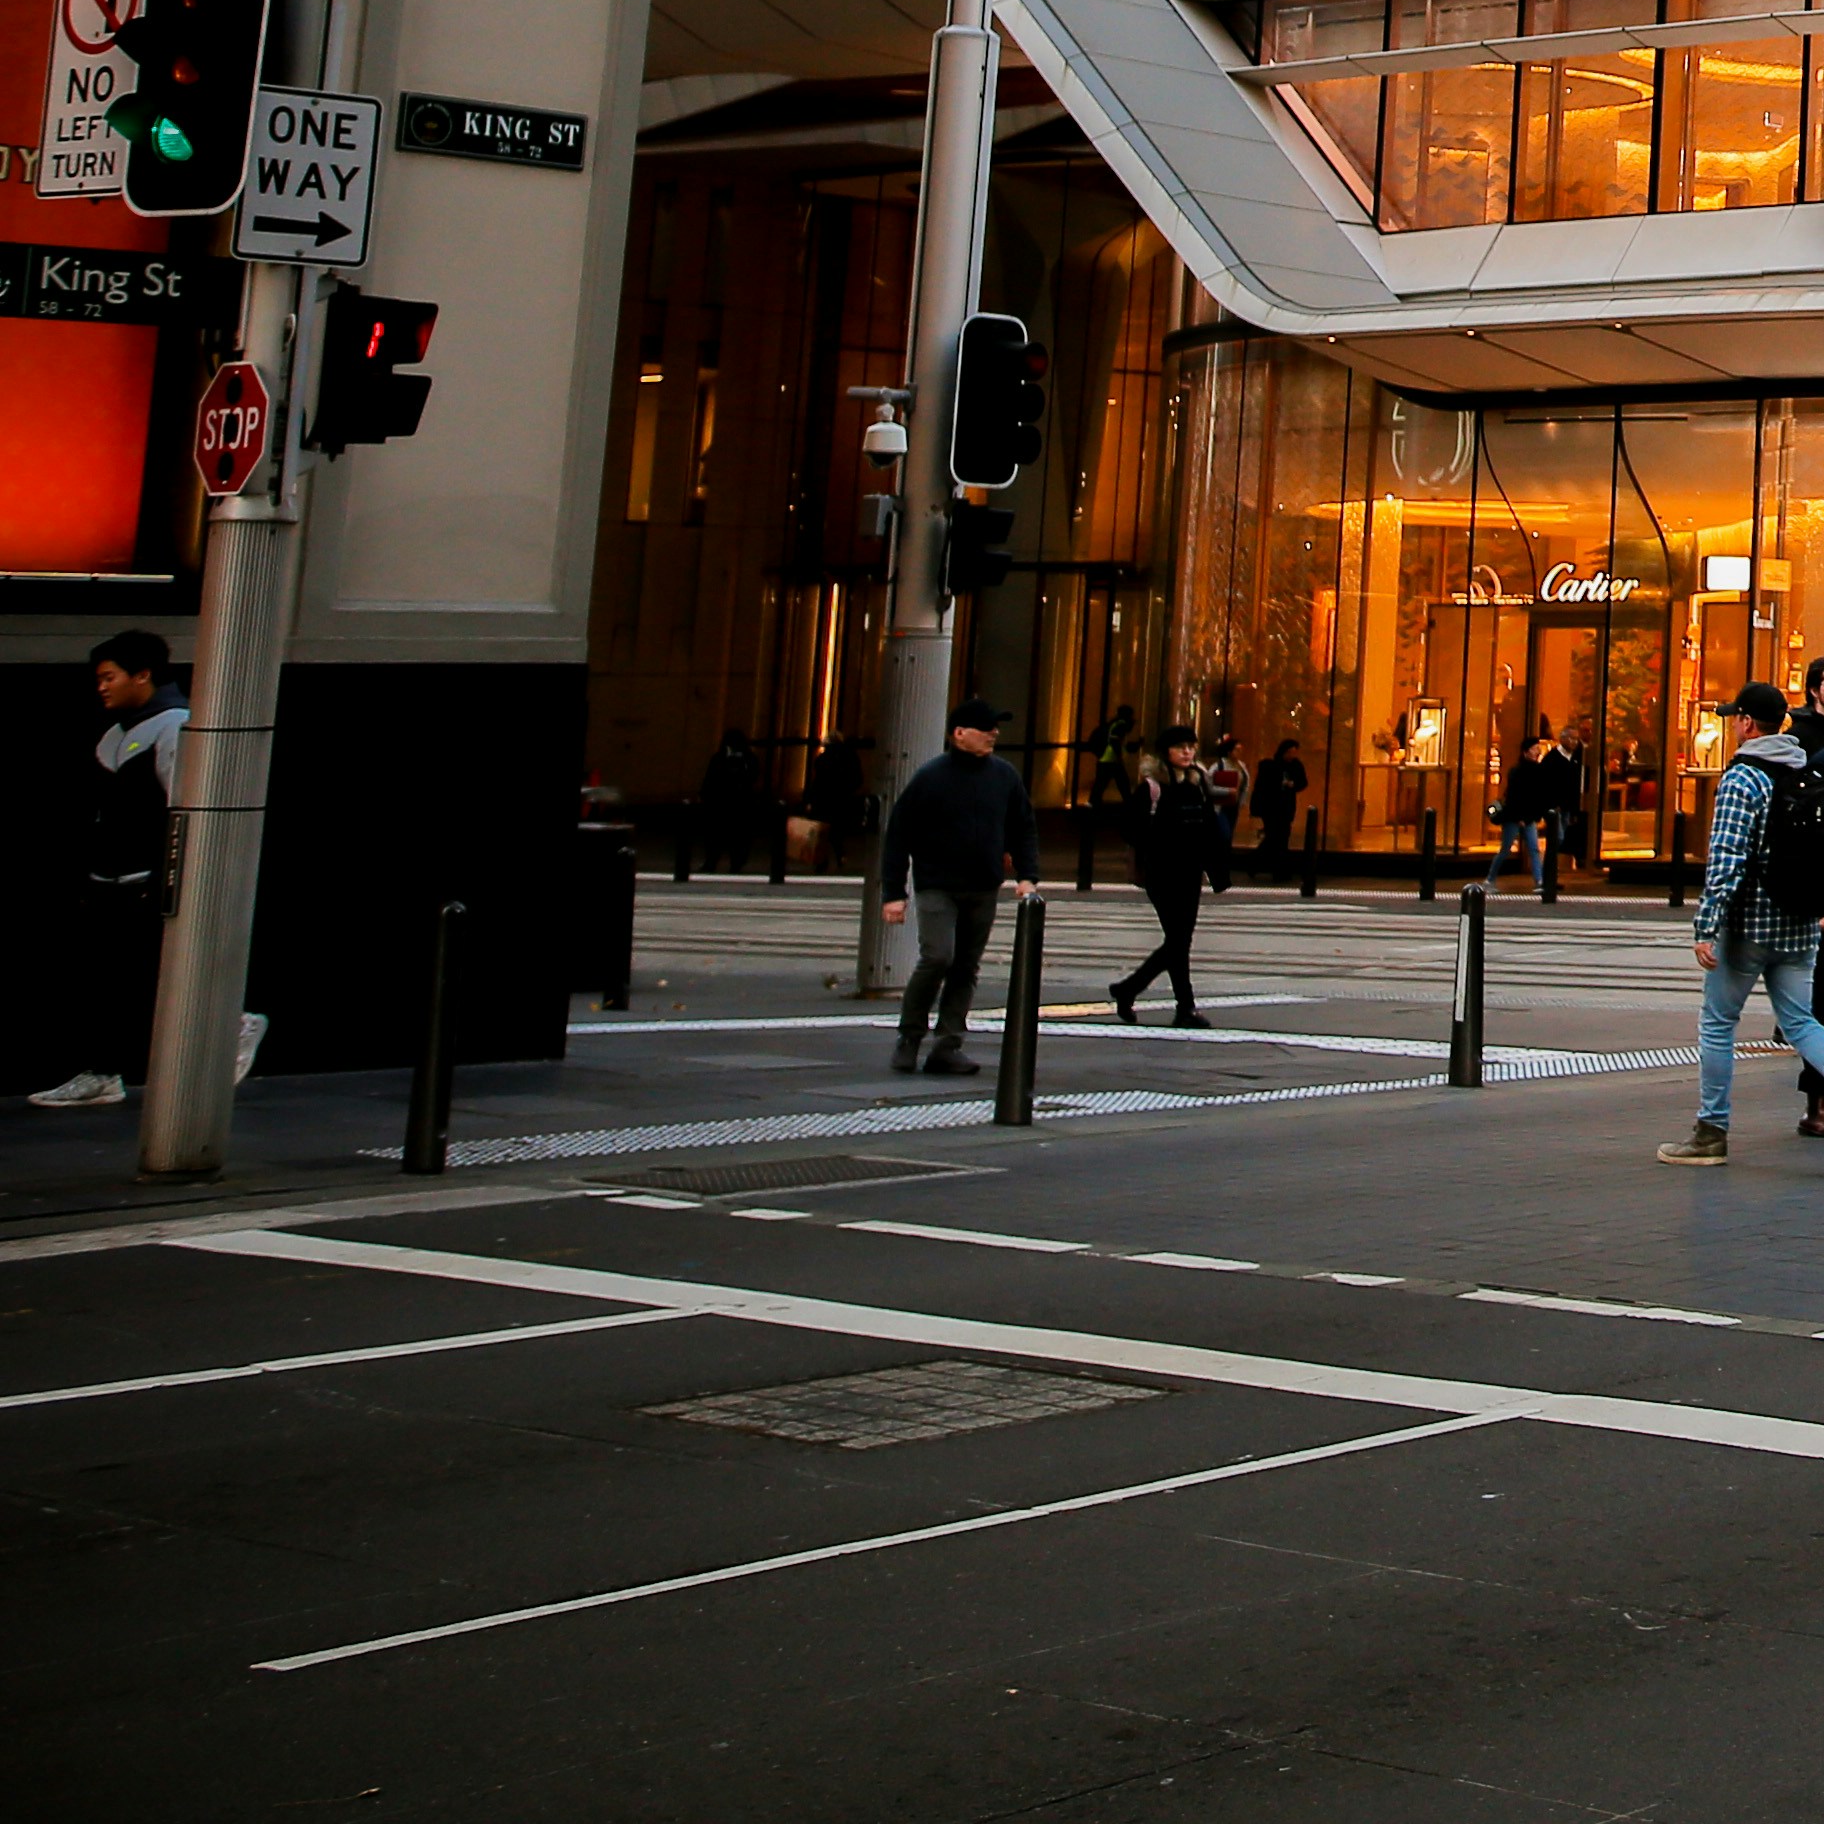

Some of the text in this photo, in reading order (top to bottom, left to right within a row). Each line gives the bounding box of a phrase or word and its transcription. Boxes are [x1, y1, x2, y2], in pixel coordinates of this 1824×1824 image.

[68, 65, 115, 103] NO
[56, 115, 112, 142] LEFT
[268, 105, 358, 151] ONE
[463, 111, 580, 147] KING ST
[52, 151, 115, 178] TURN
[257, 157, 360, 203] WAY
[40, 256, 182, 304] King St
[39, 301, 58, 314] 58
[83, 303, 103, 317] 72
[203, 407, 260, 451] STOP
[1540, 562, 1640, 603] Cartier
